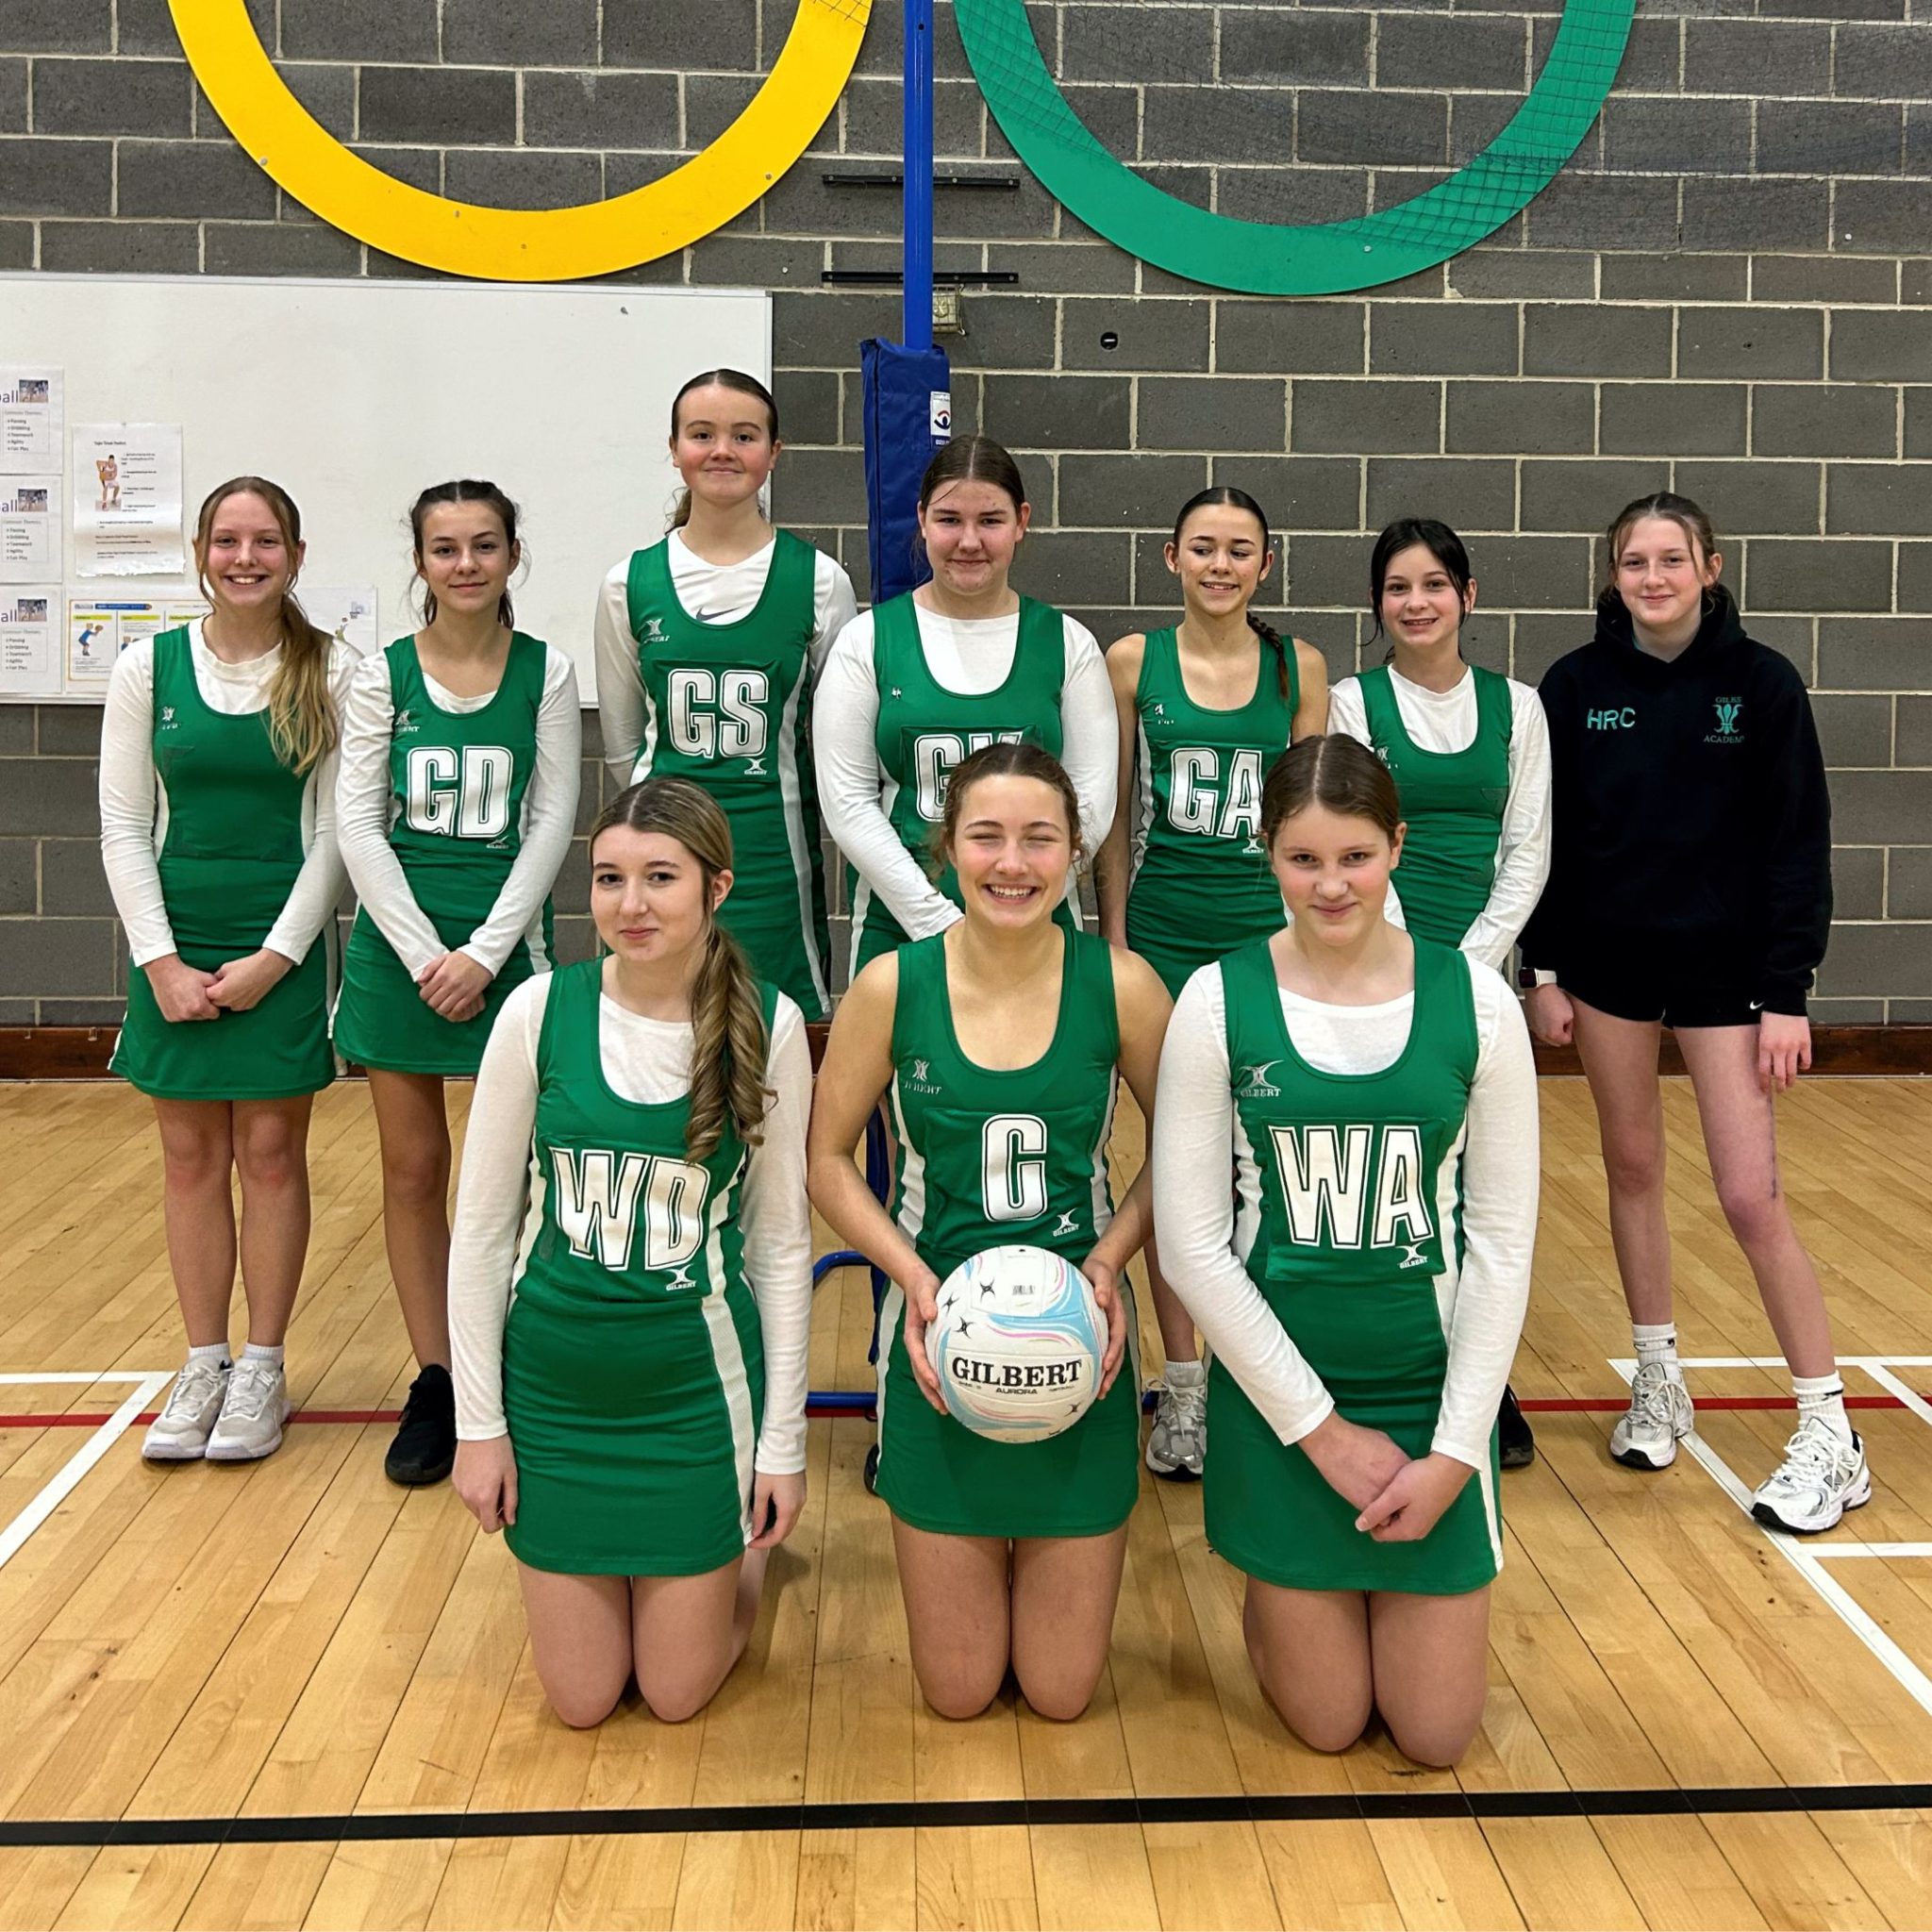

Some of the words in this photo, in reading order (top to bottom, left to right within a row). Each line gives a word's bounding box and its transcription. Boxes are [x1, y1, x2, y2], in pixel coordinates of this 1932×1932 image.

[0, 499, 18, 512] all
[668, 669, 769, 759] GS
[1587, 707, 1637, 731] HRC
[406, 745, 514, 839] GD
[914, 731, 1024, 823] G
[1167, 747, 1264, 839] GA
[548, 1146, 711, 1272] WD
[981, 1113, 1048, 1223] C
[1268, 1124, 1435, 1250] WA
[665, 1280, 697, 1291] GILBERT
[951, 1356, 1084, 1389] GILBERT
[995, 1387, 1039, 1395] AURORA
